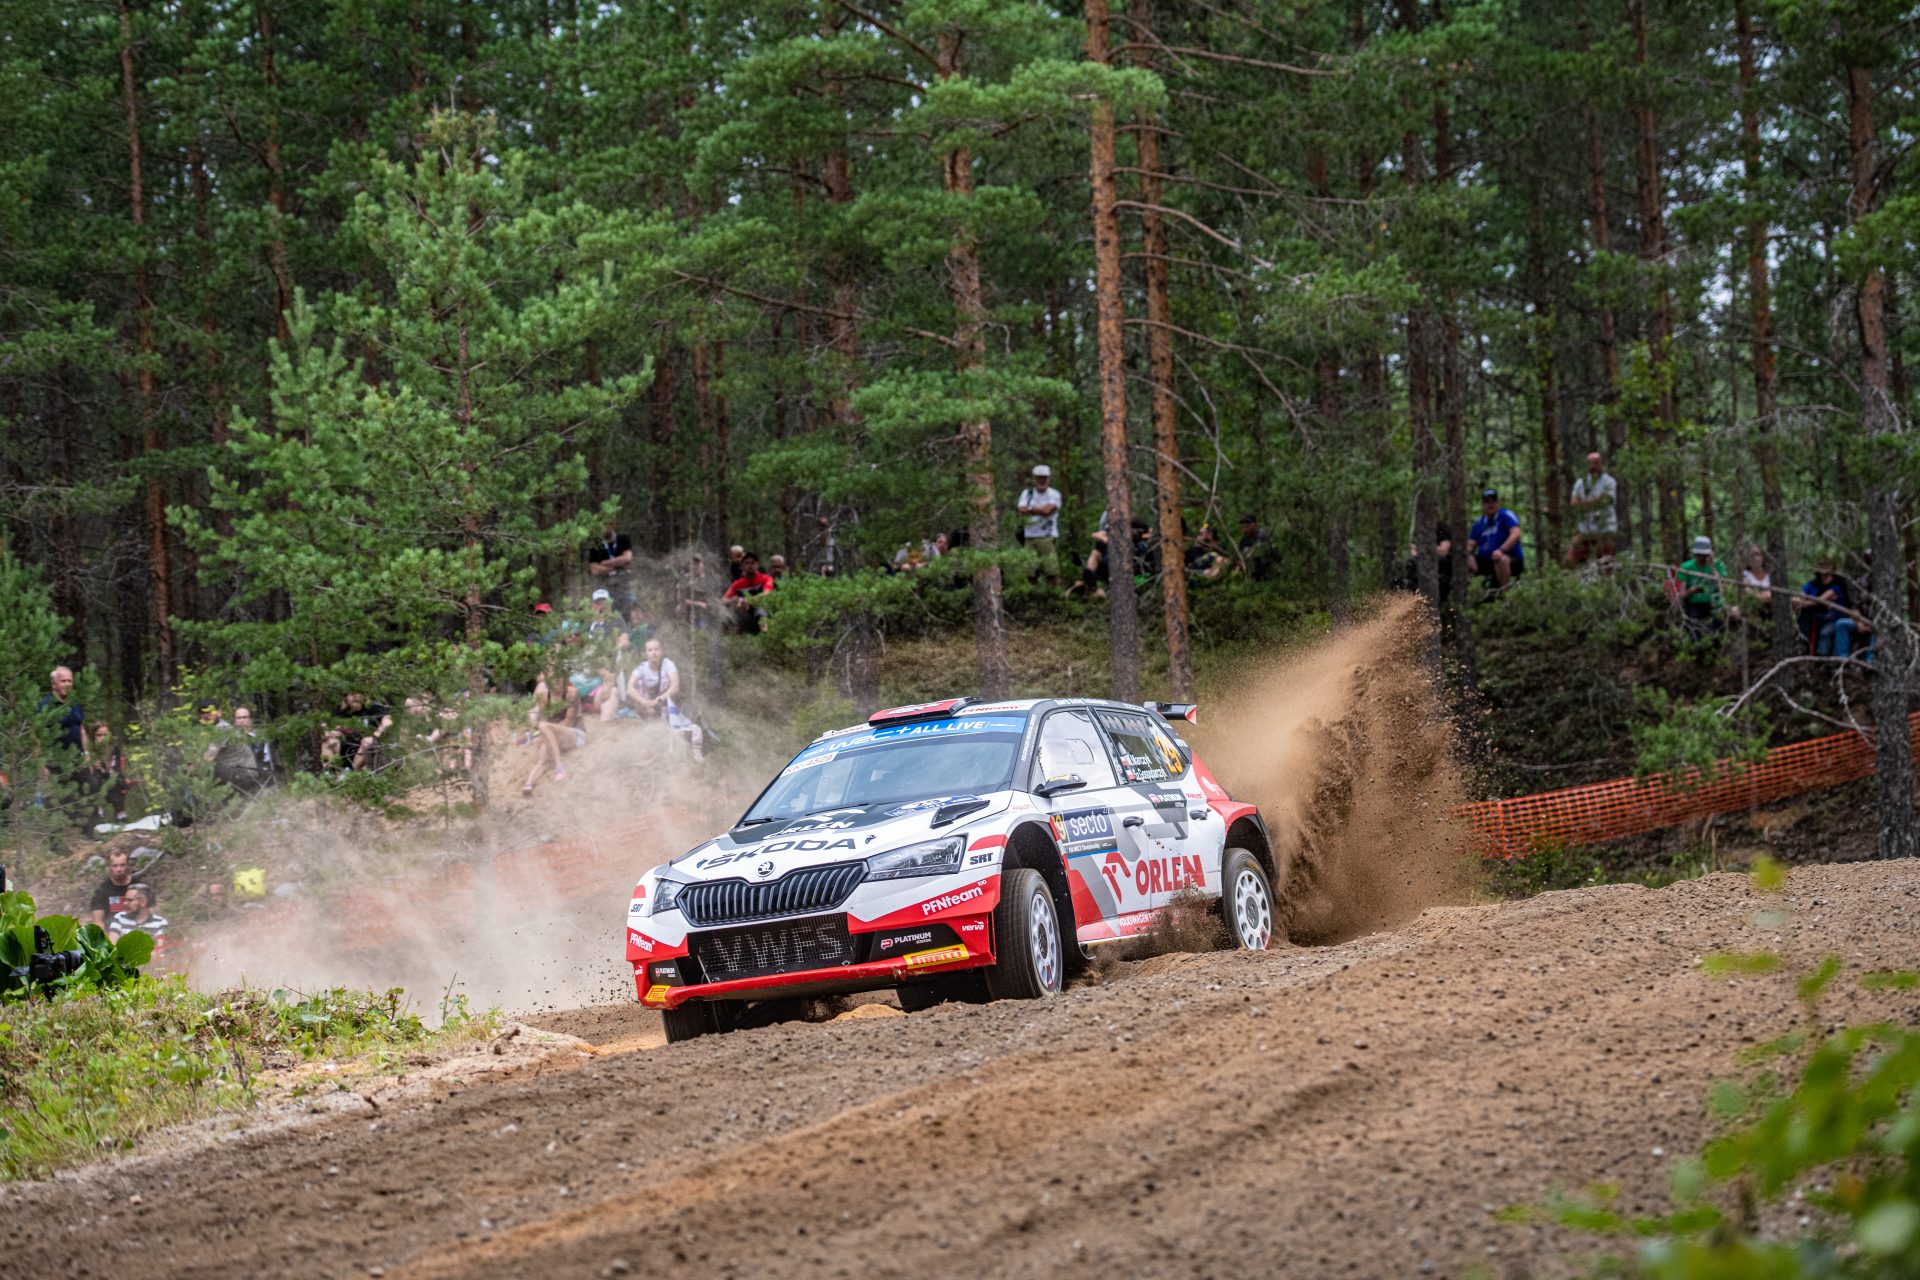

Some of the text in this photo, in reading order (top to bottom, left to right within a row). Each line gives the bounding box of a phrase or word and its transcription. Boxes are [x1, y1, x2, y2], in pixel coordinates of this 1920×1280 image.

[945, 720, 988, 731] LIVE
[1069, 810, 1108, 837] secto
[703, 838, 857, 870] ŠKODA
[970, 851, 993, 865] SRT
[1136, 854, 1206, 896] ORLEN
[922, 886, 983, 915] PFNteam
[894, 931, 932, 944] PLATINUM
[962, 923, 985, 932] verva
[713, 922, 842, 972] VWFS
